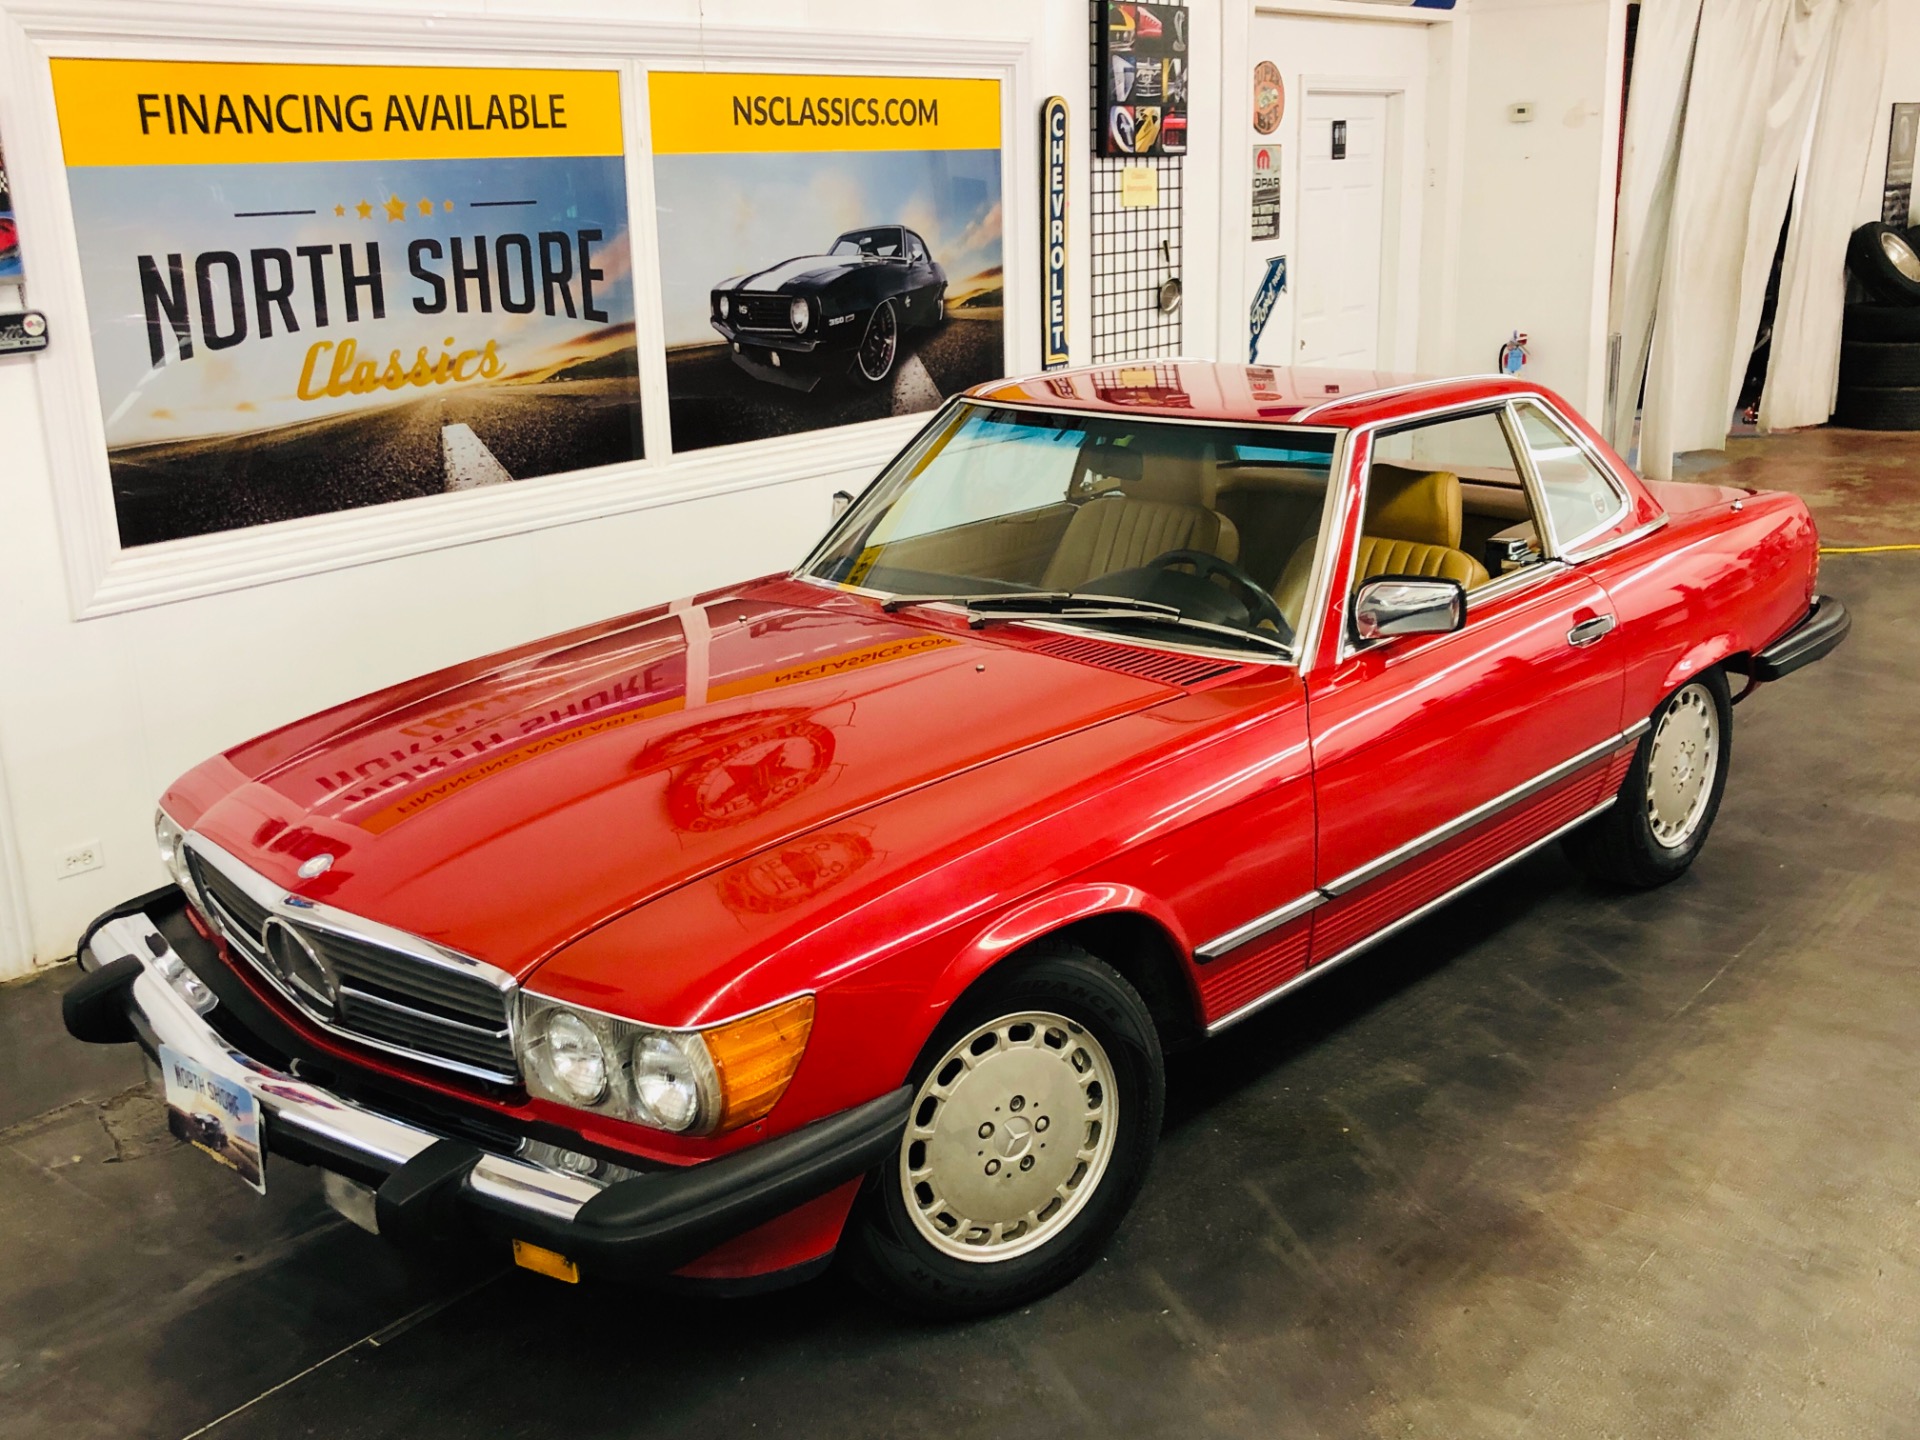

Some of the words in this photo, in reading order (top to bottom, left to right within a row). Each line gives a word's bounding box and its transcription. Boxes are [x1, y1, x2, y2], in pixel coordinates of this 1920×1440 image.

[137, 93, 373, 136] FINANCING
[383, 93, 568, 131] AVAILABLE
[732, 95, 939, 127] NSCLASSICS.COM
[1050, 112, 1065, 350] CHEVROLET
[136, 242, 387, 370] NORTH
[407, 229, 610, 324] SHORE
[828, 315, 845, 327] 350
[1252, 282, 1275, 334] Ford
[296, 337, 507, 401] Classics
